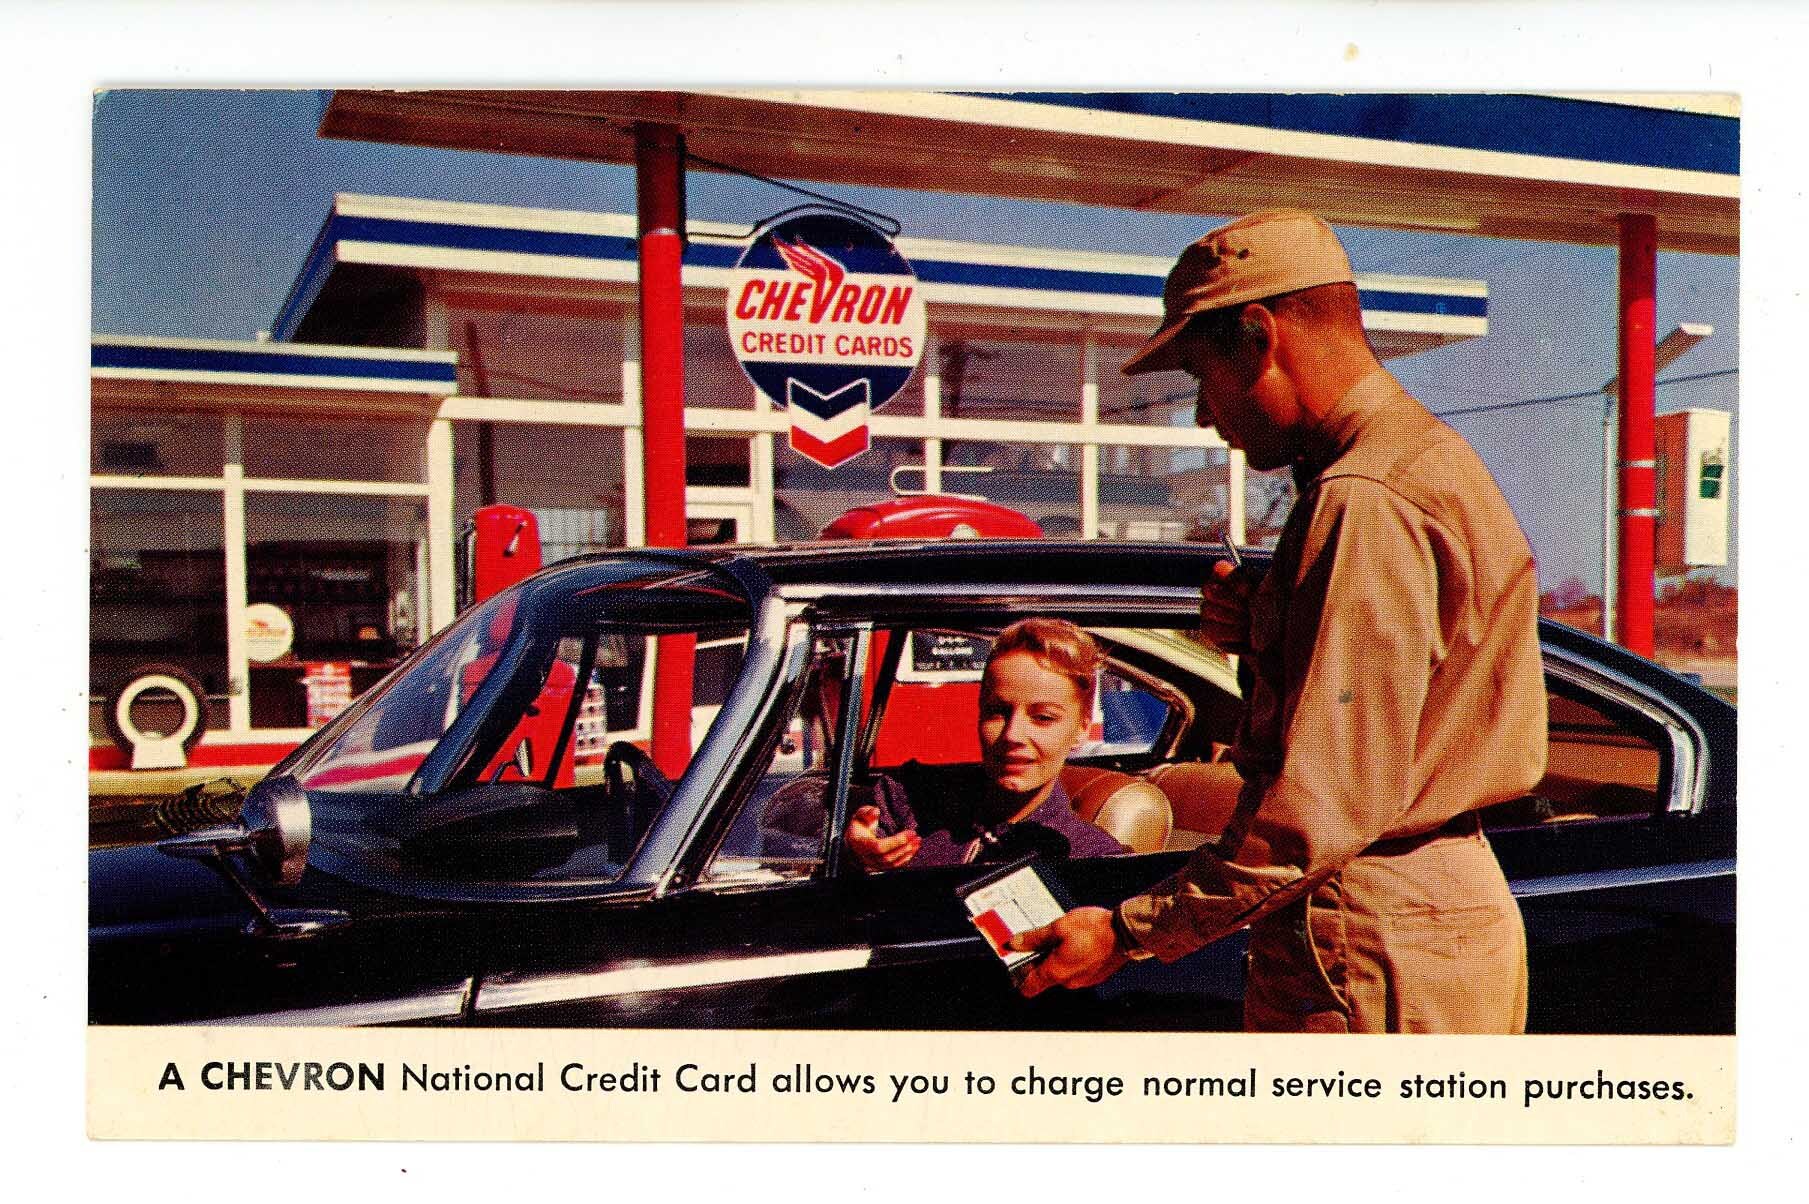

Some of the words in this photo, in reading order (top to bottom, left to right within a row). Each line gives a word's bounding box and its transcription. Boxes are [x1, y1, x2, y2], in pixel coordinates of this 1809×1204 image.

[735, 266, 912, 324] CHEVRON
[742, 331, 825, 354] CREDIT
[835, 335, 913, 358] CARDS
